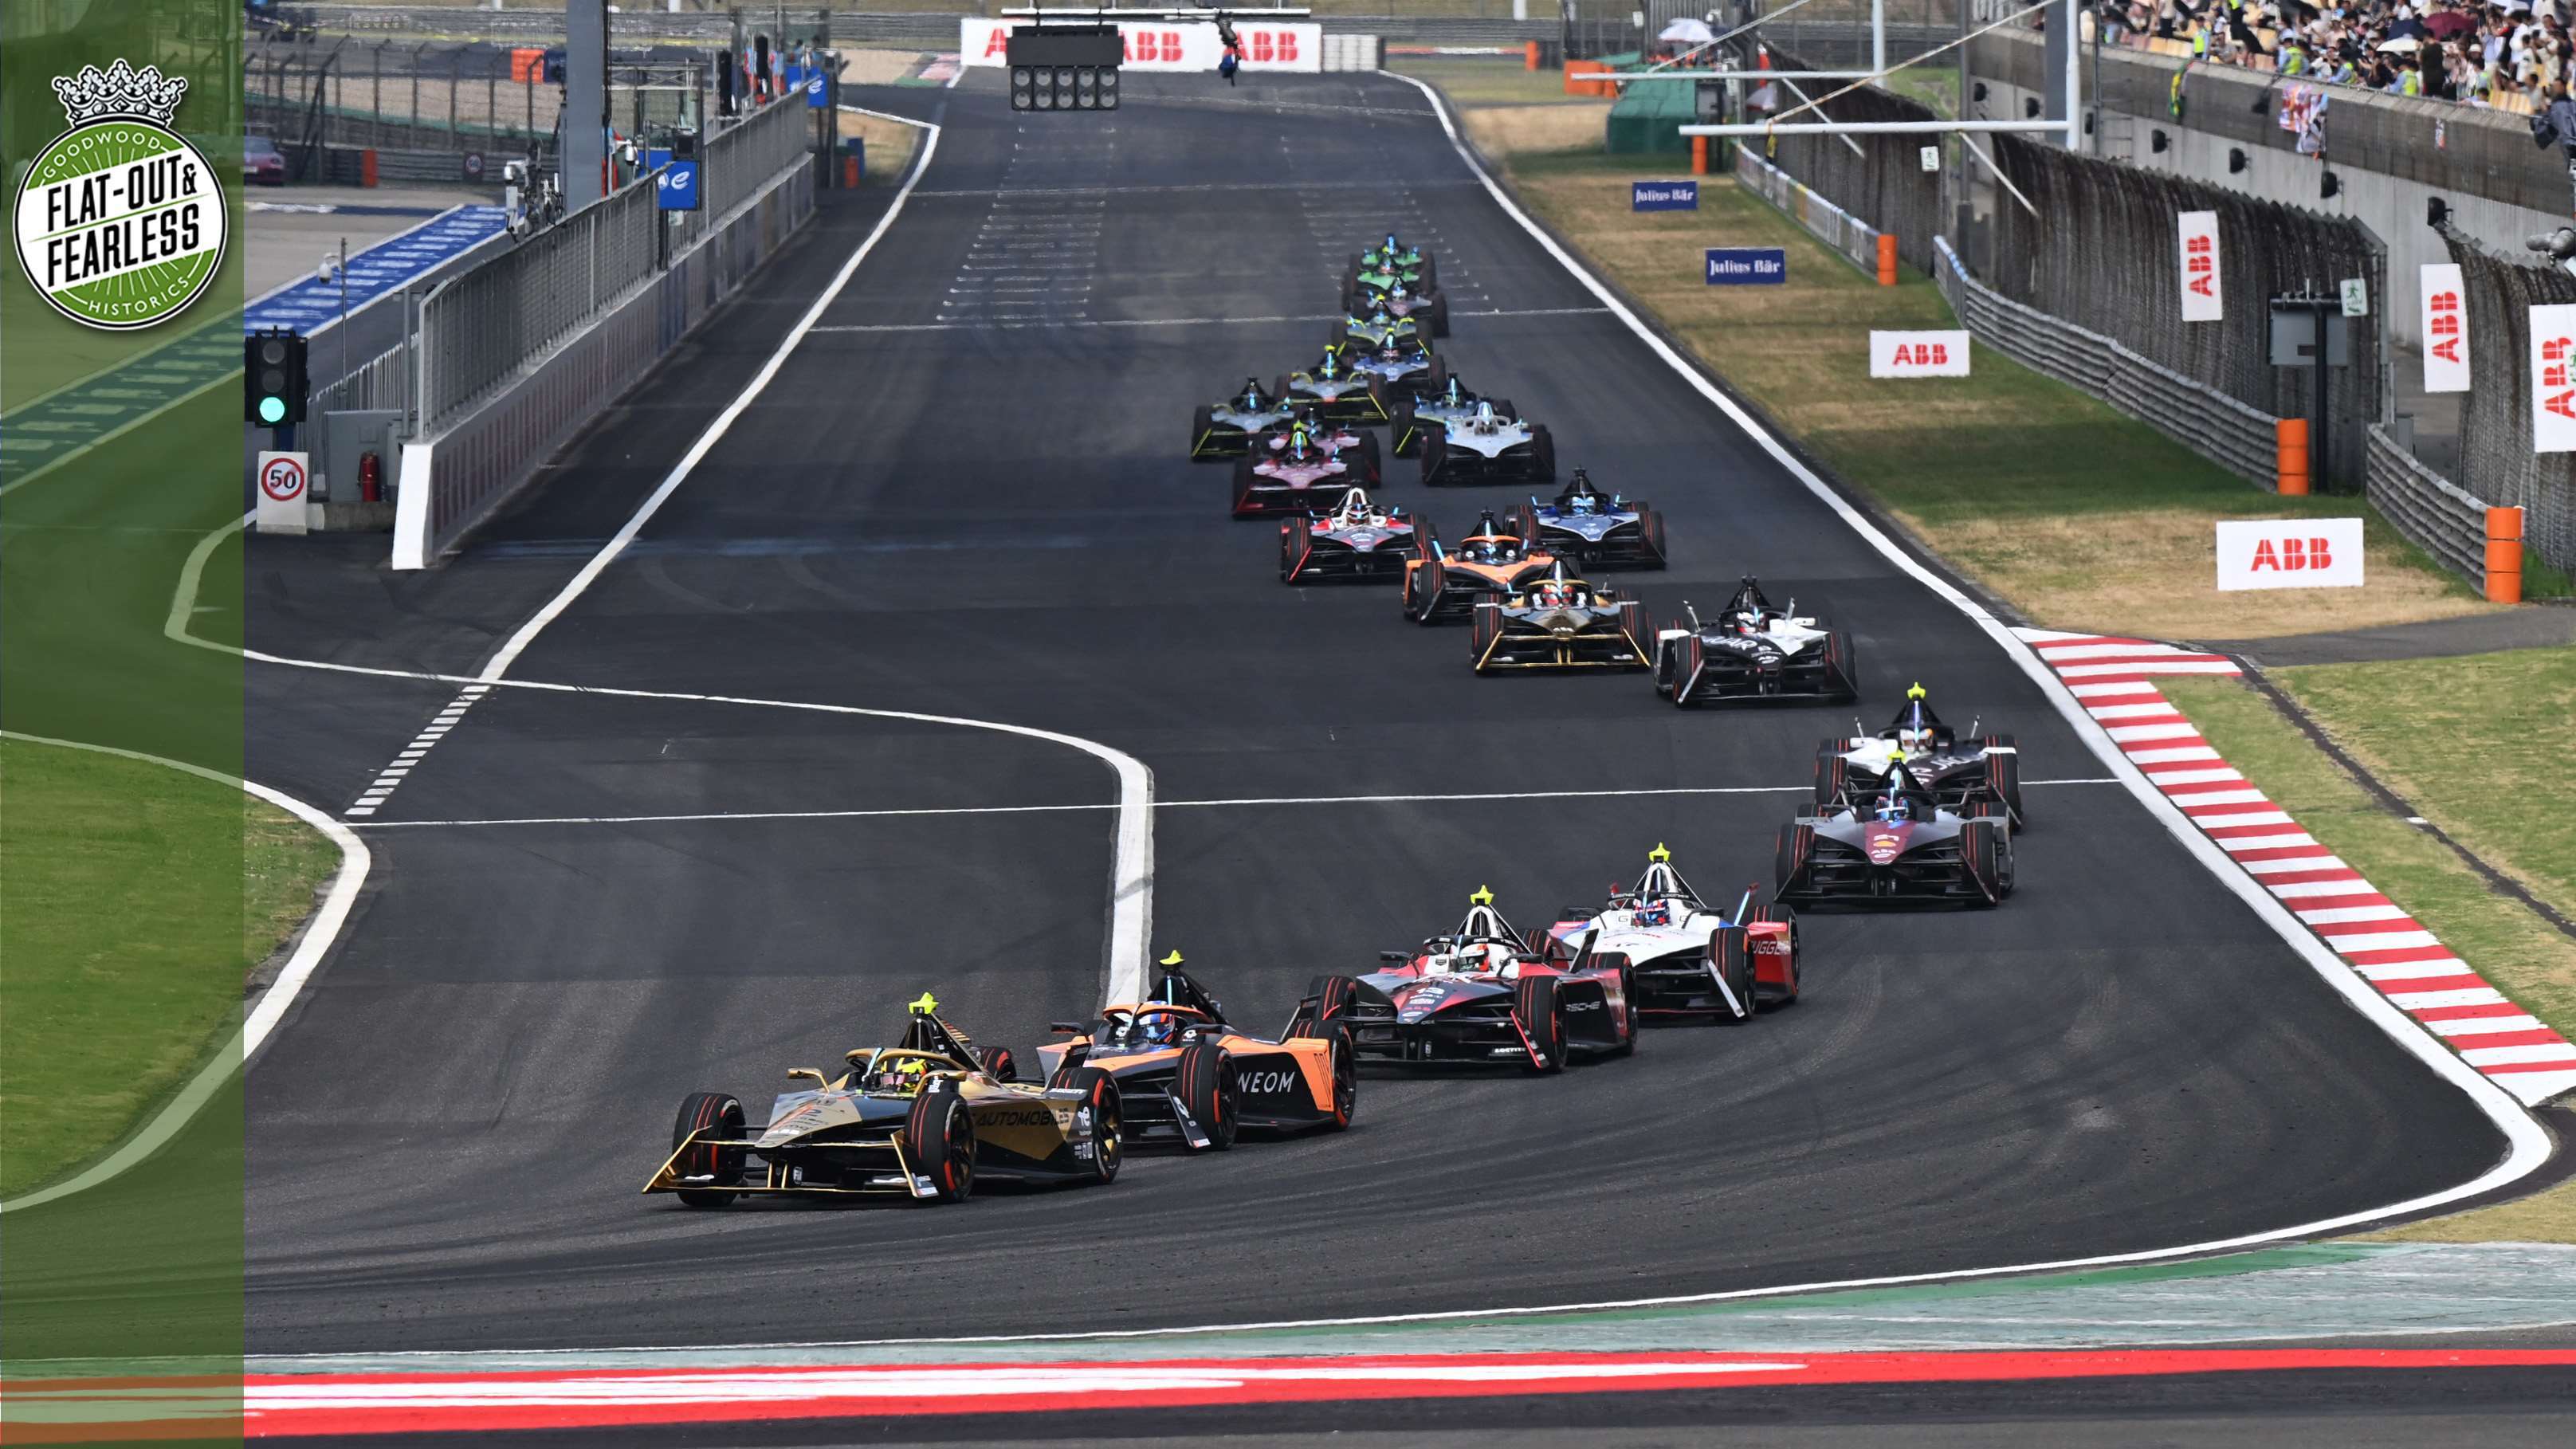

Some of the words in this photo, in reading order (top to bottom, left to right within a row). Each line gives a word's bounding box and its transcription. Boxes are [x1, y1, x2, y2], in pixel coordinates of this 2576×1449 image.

[1636, 189, 1671, 202] Julius
[1672, 189, 1694, 201] Bär
[1710, 259, 1751, 276] Julius
[1754, 259, 1781, 273] Bär
[2186, 234, 2213, 297] ABB
[2430, 291, 2460, 364] ABB
[1892, 343, 1949, 366] ABB
[269, 469, 297, 489] 50
[2250, 537, 2333, 571] ABB
[1238, 1071, 1295, 1094] NEOM
